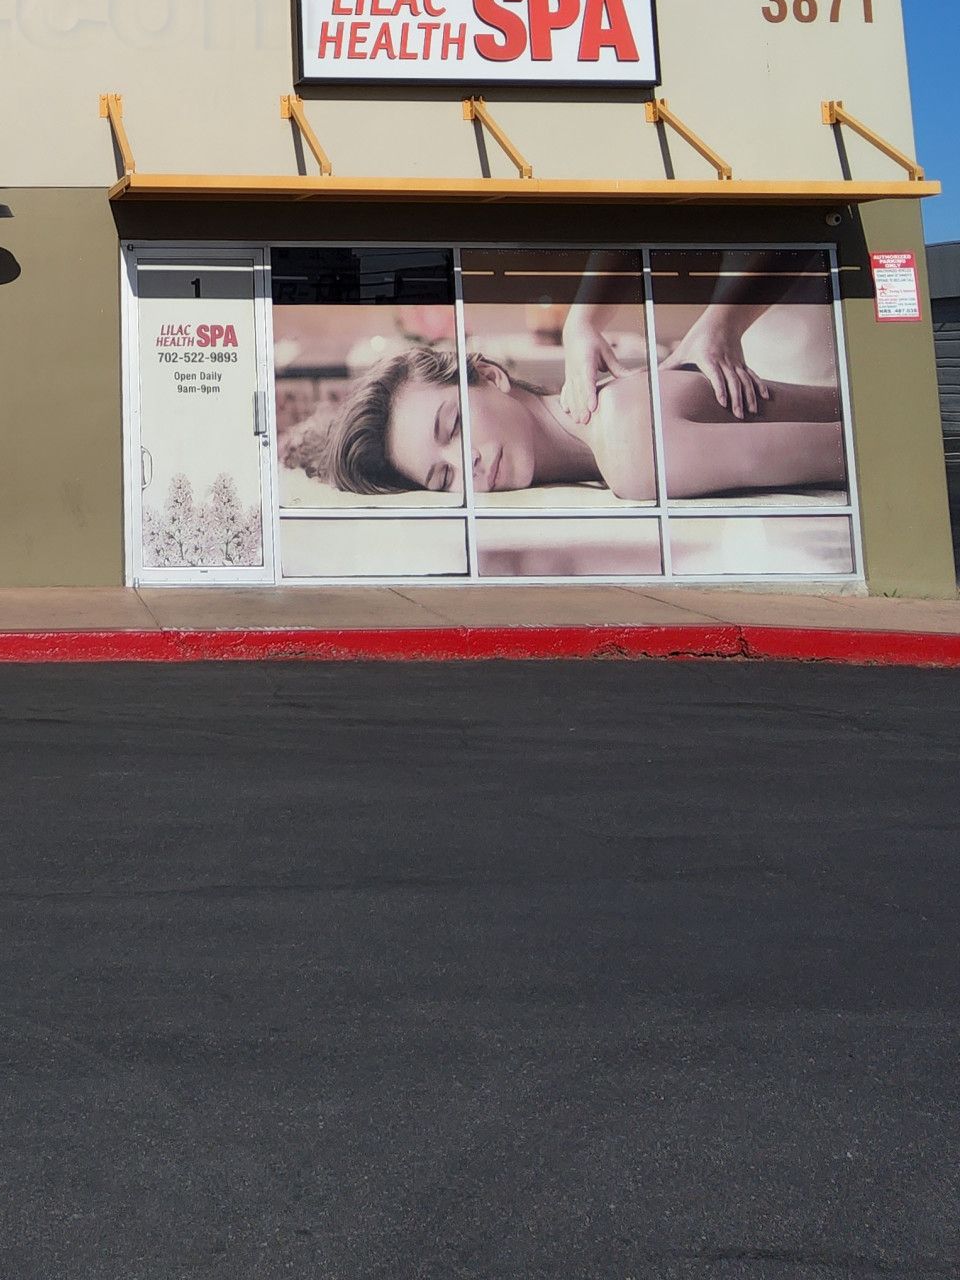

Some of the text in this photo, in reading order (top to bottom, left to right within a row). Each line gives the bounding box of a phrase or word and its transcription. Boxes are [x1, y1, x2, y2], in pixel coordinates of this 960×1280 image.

[318, 21, 467, 60] HEALTH
[191, 278, 201, 298] 1
[156, 324, 239, 347] HEALTH SPA
[160, 324, 192, 336] LILAC
[157, 352, 238, 363] 702-522-9893
[174, 371, 222, 382] Open Daily
[177, 384, 221, 395] 9am-9pm
